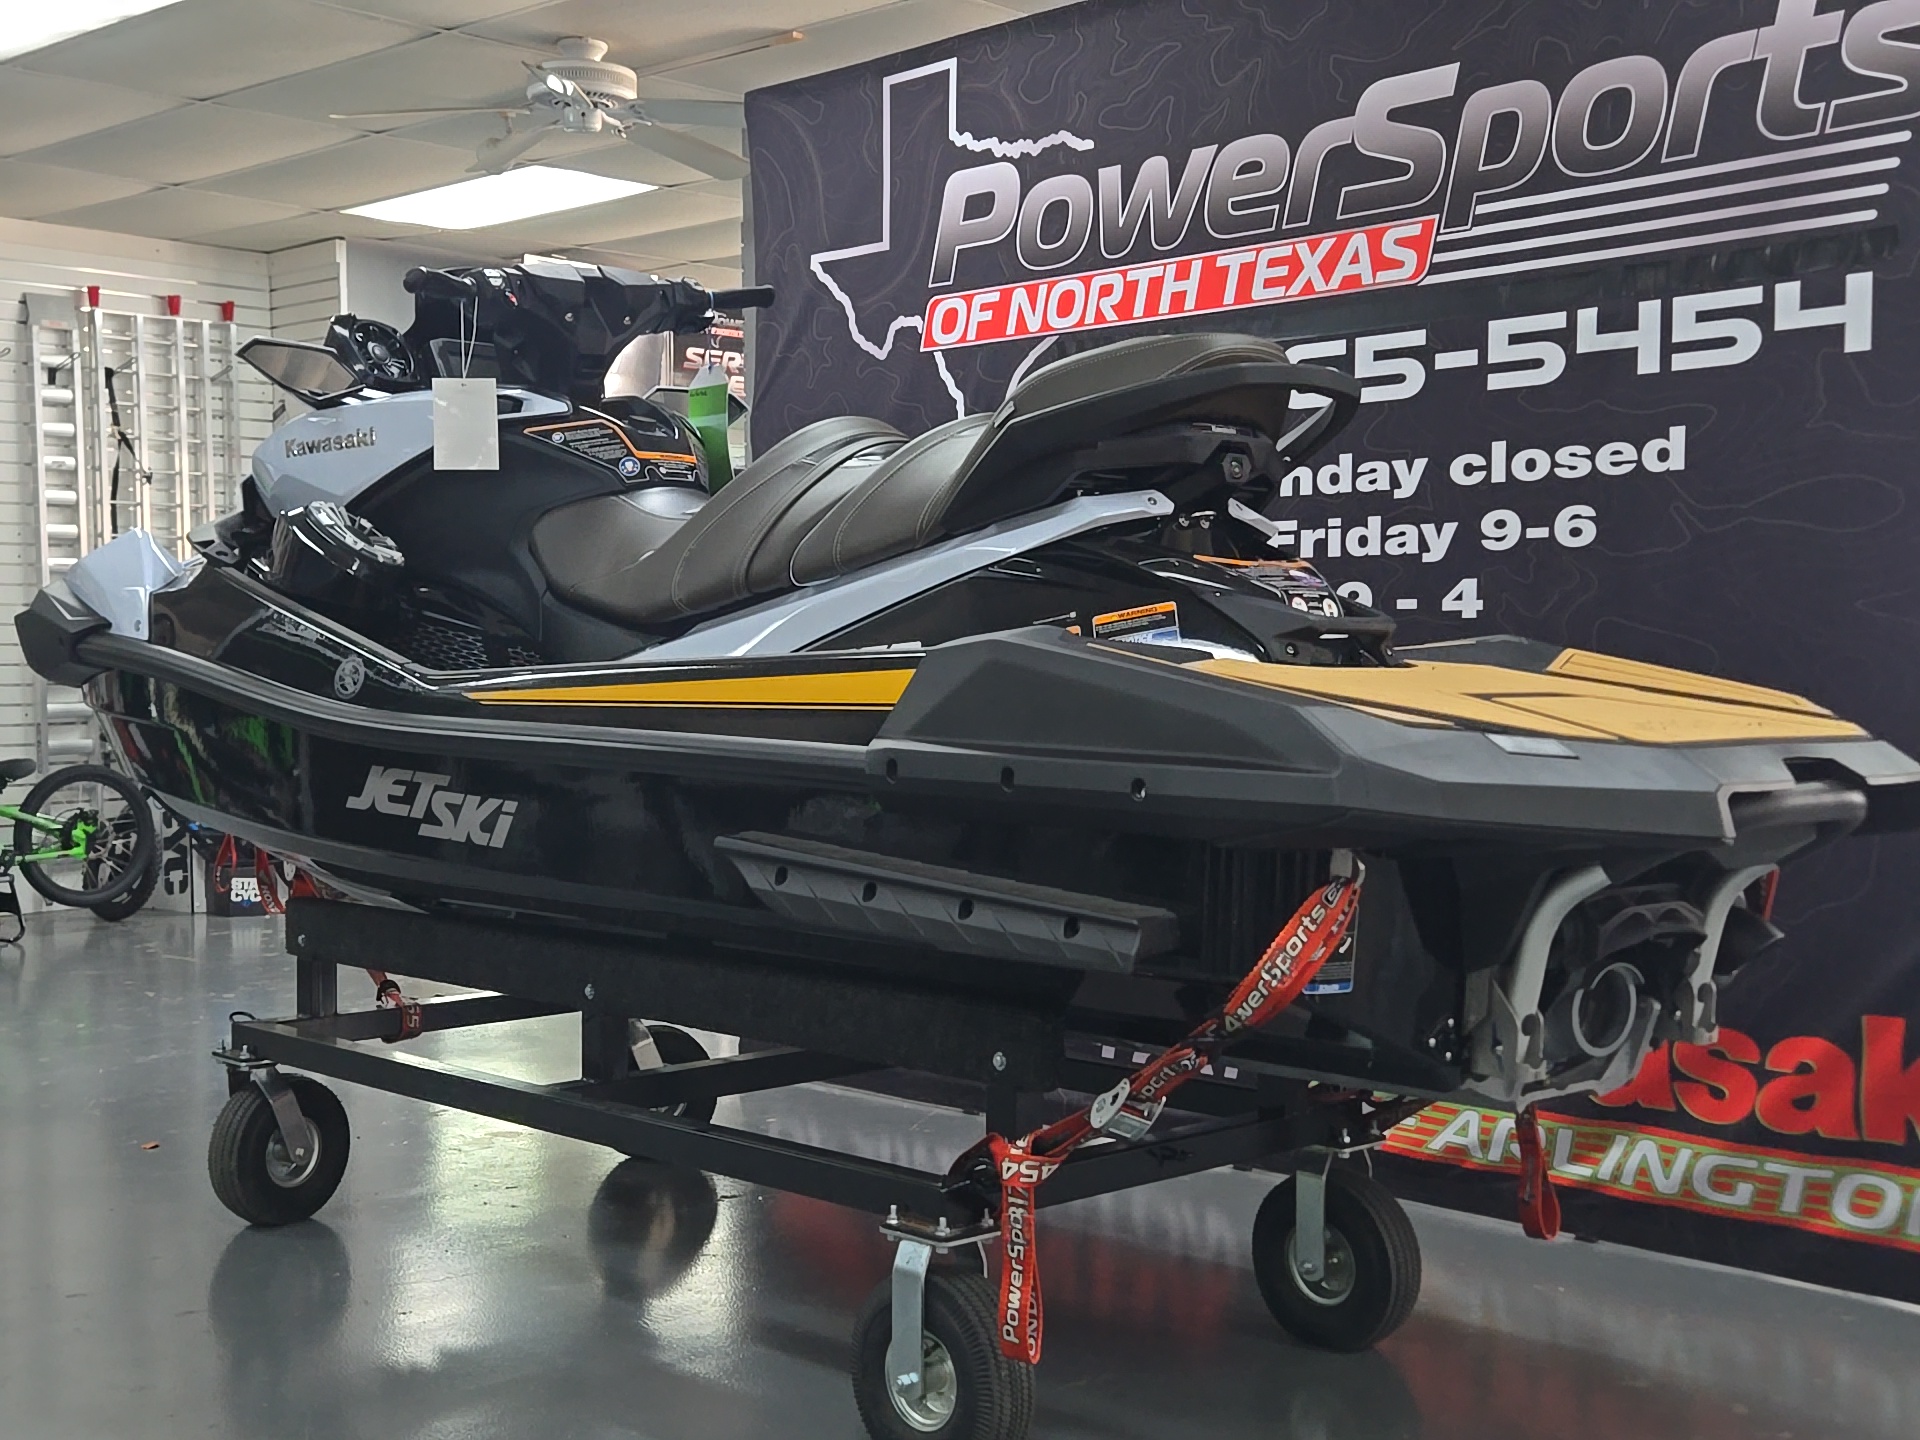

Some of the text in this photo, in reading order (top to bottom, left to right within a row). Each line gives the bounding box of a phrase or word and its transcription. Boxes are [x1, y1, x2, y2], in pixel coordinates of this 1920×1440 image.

[929, 0, 1920, 288] PowerSports
[931, 222, 1427, 346] OF NORTH TEXAS
[284, 426, 377, 459] Kawasaki
[1449, 425, 1686, 488] closed
[1480, 504, 1598, 552] 9-6
[1117, 606, 1158, 619] WARNING
[1441, 577, 1484, 619] 4
[346, 765, 451, 819] JET
